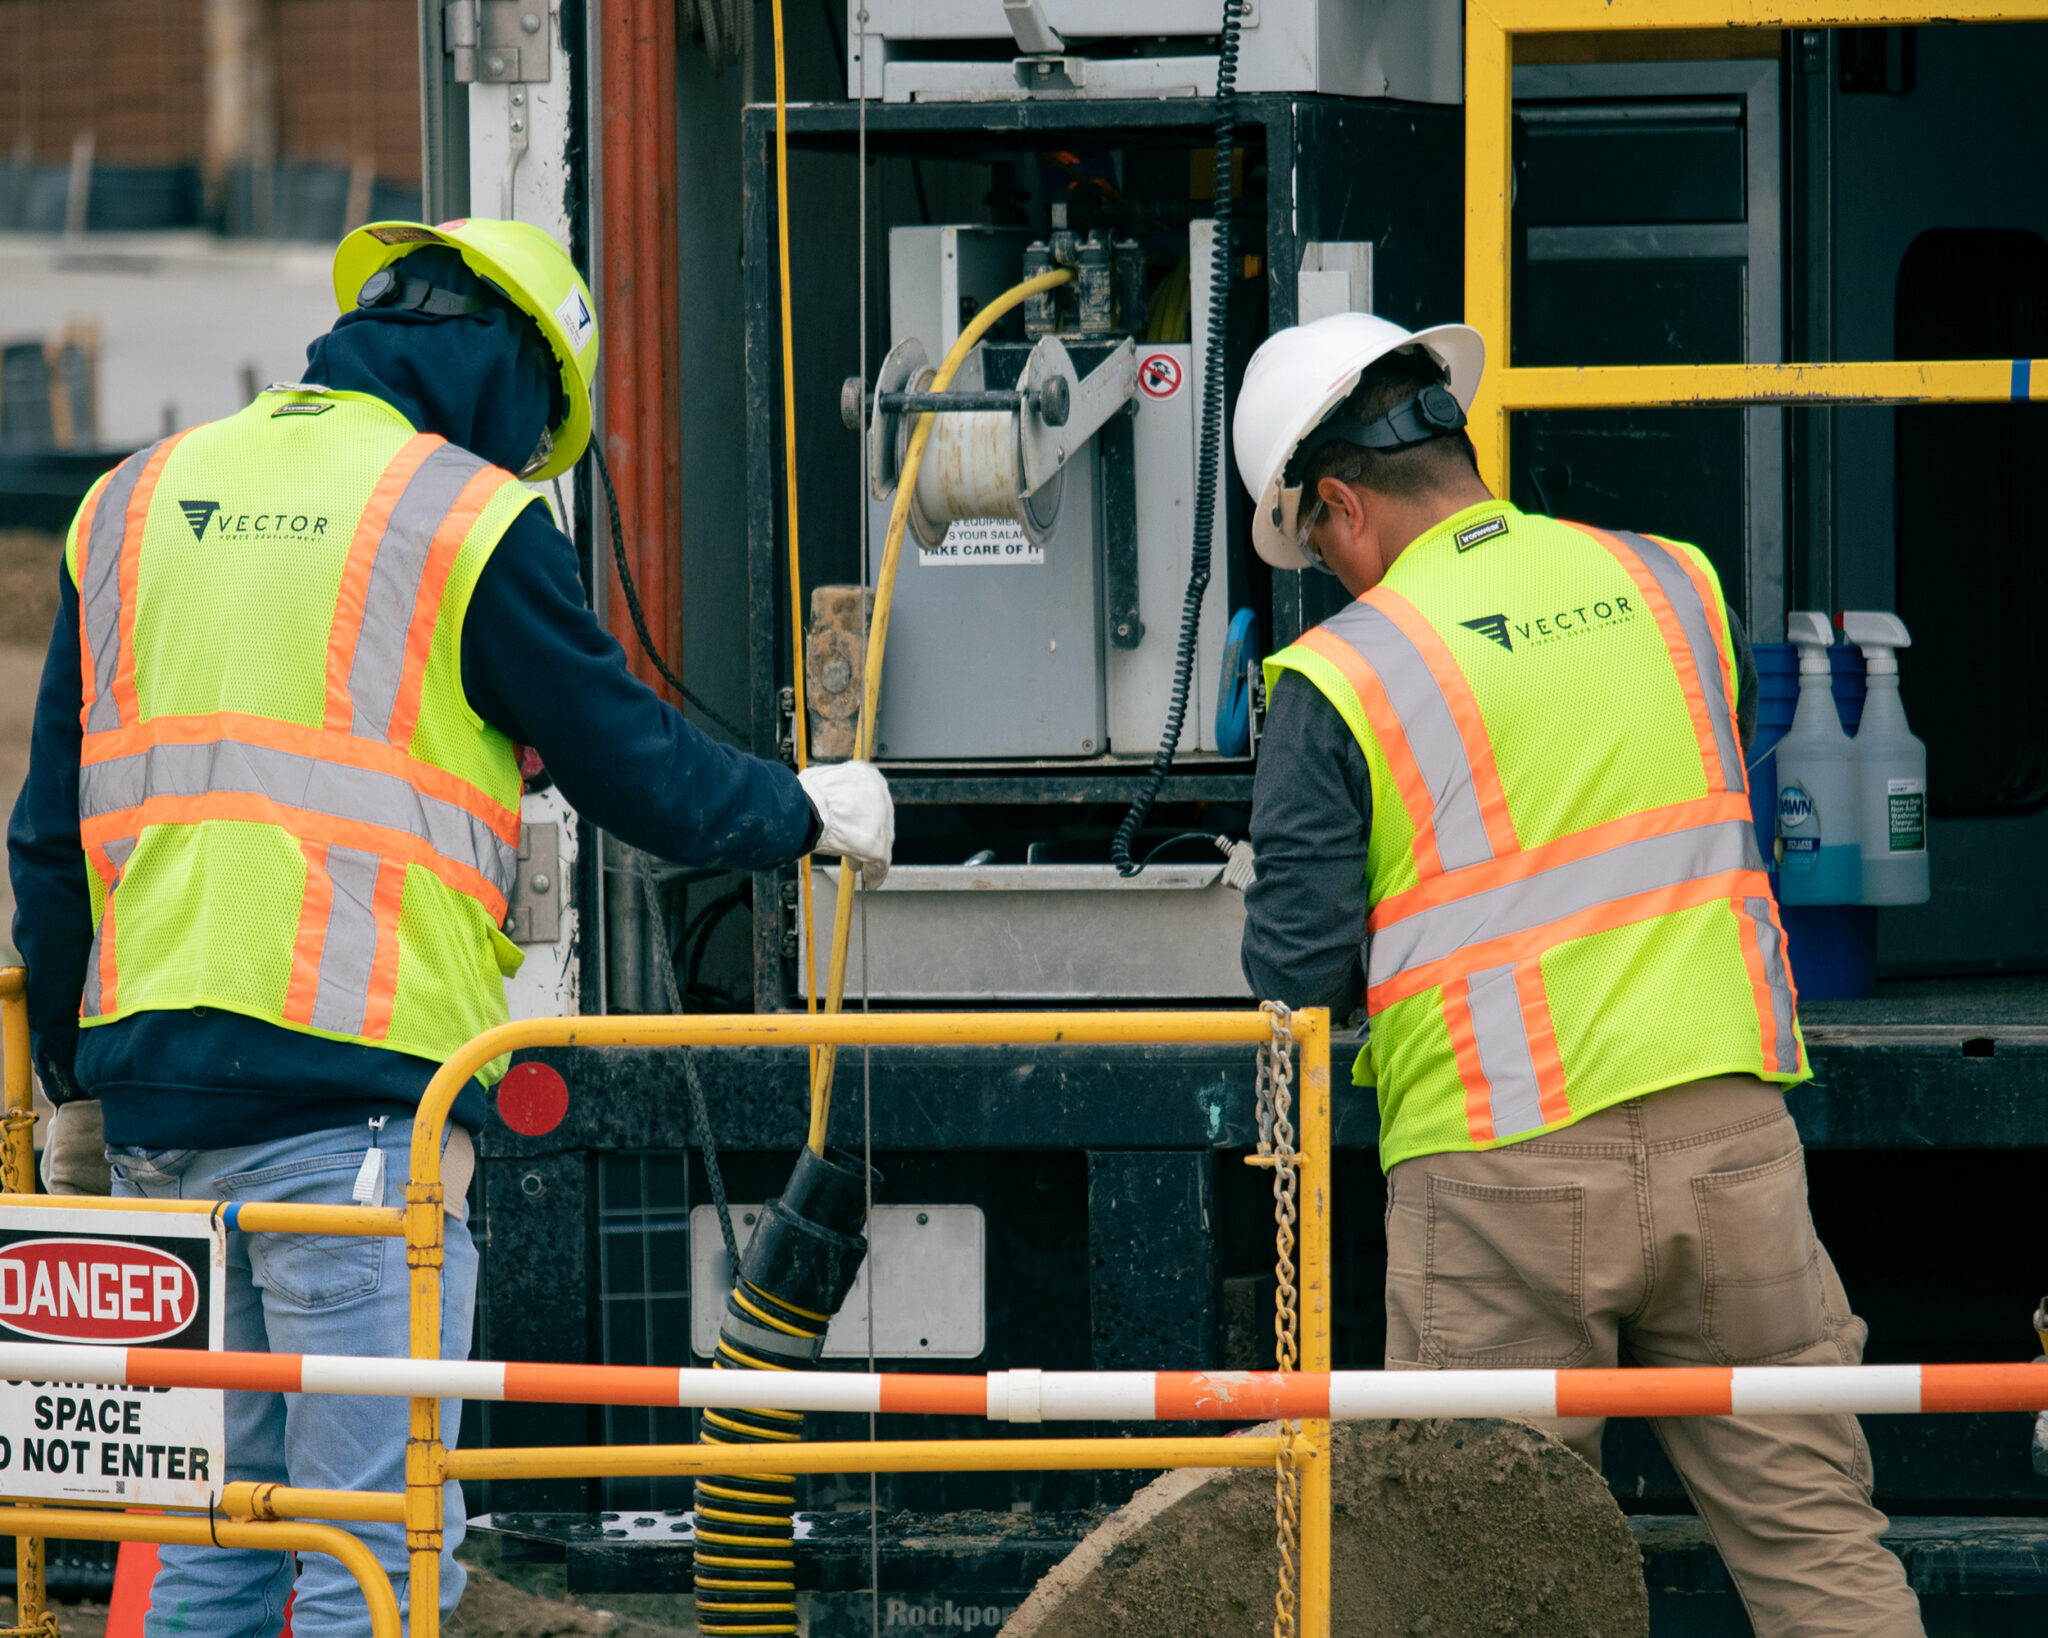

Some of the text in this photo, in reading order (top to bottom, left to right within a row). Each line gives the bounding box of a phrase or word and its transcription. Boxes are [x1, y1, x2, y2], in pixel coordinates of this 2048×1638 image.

[219, 515, 328, 534] VECTOR
[957, 530, 988, 540] YOUR
[990, 530, 1023, 540] SALA
[963, 518, 1020, 527] EQUIPMEN
[963, 544, 1001, 555] CARE
[1005, 544, 1023, 555] OF
[1515, 597, 1633, 639] VECTOR
[0, 1258, 183, 1323] DANGER
[34, 1395, 141, 1434] SPACE
[23, 1437, 91, 1474] NOT
[101, 1442, 209, 1481] ENTER
[886, 1598, 1019, 1632] Rockpor
